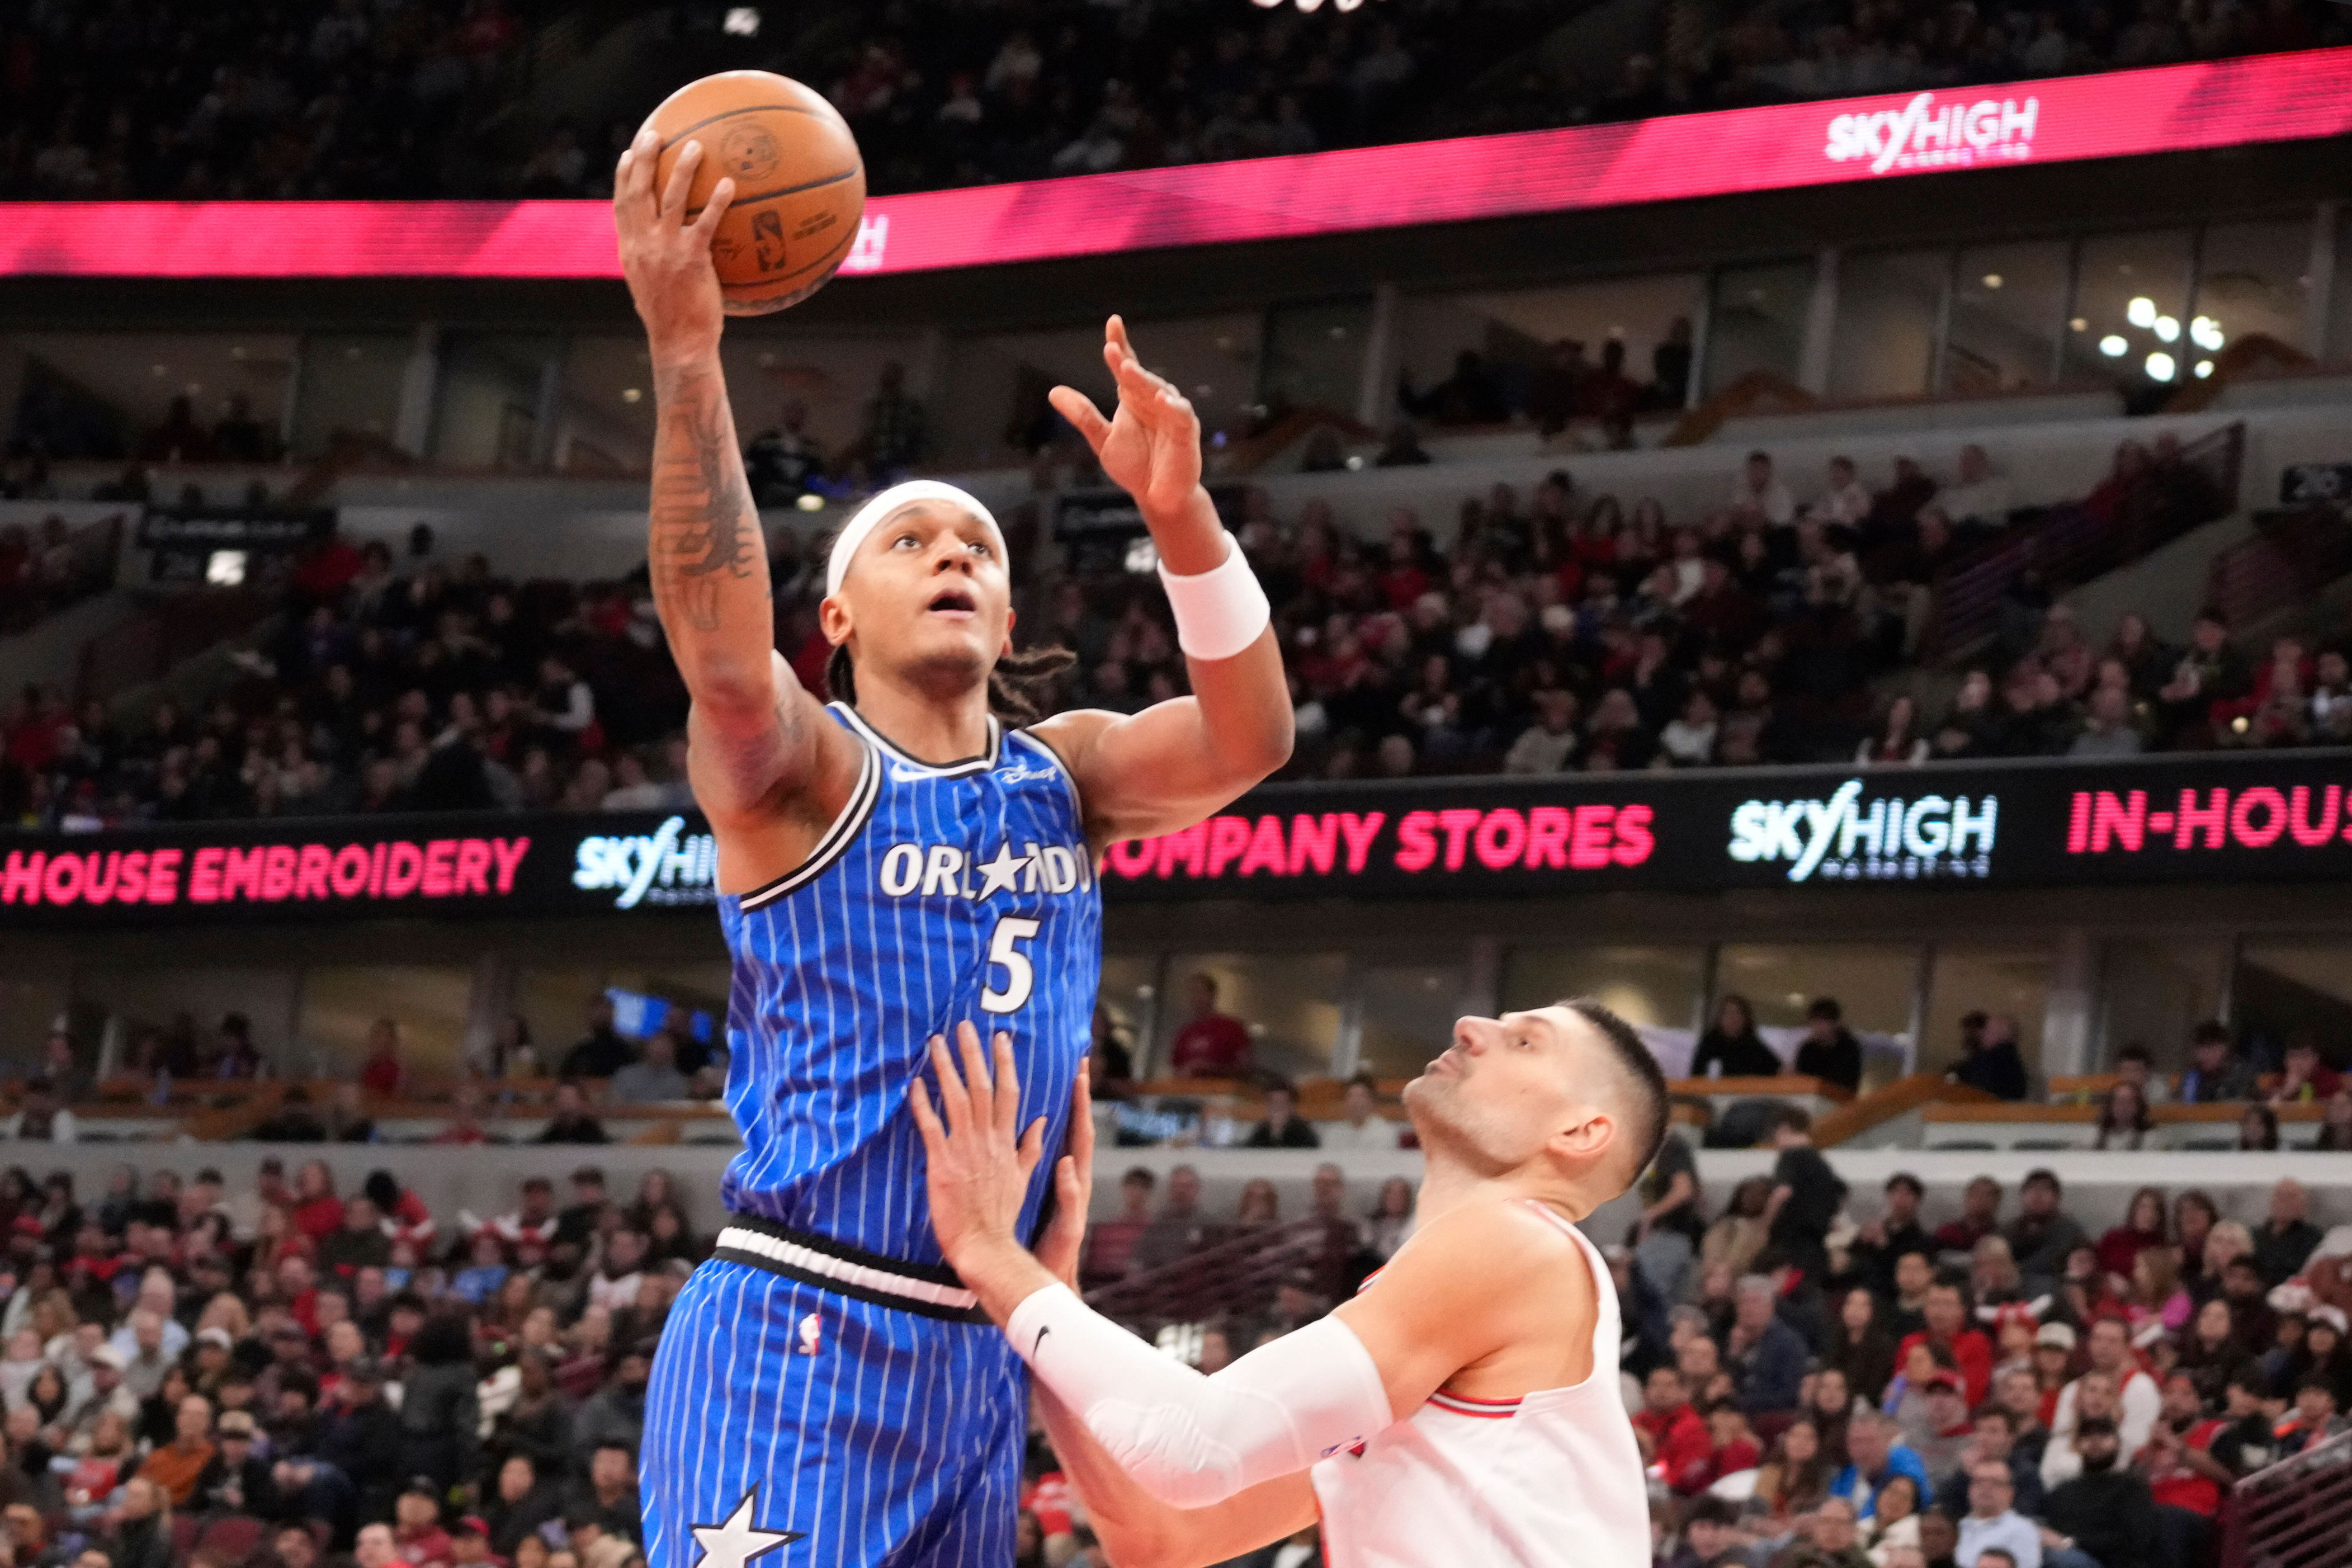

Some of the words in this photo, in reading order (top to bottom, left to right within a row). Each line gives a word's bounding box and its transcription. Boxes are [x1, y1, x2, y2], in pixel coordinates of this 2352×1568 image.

[1099, 811, 1386, 880] OMPANY
[1395, 804, 1655, 872] STORES
[2067, 785, 2352, 853] IN-HOU
[0, 848, 182, 905] HOUSE
[188, 837, 531, 903] EMBROIDERY
[572, 815, 718, 908] SKYHI
[980, 916, 1041, 1013] 5
